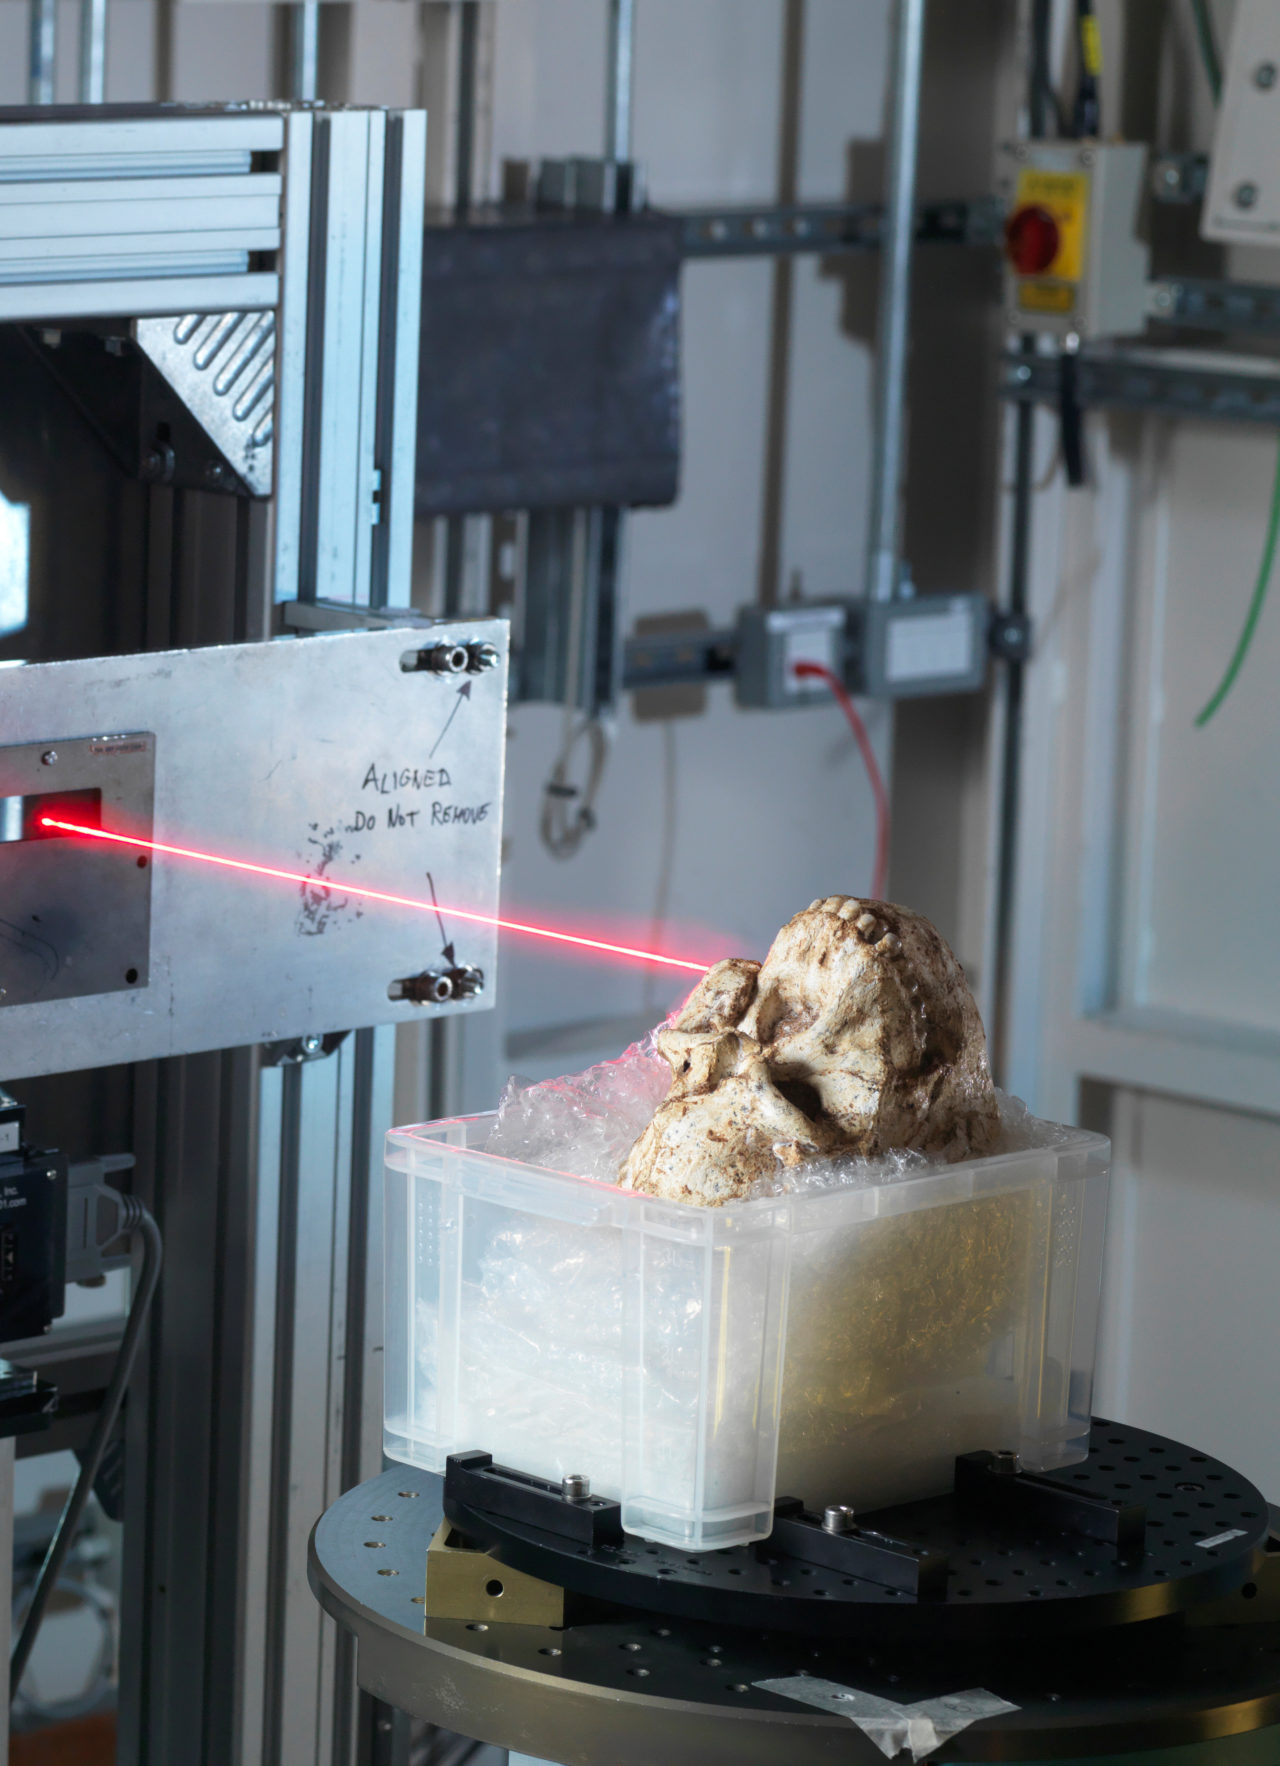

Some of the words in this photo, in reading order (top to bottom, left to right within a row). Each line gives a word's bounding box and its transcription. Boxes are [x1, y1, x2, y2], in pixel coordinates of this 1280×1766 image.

[361, 762, 452, 794] ALIGNED
[354, 810, 376, 831] DO
[387, 803, 419, 829] NOT
[431, 801, 492, 826] REMOVE
